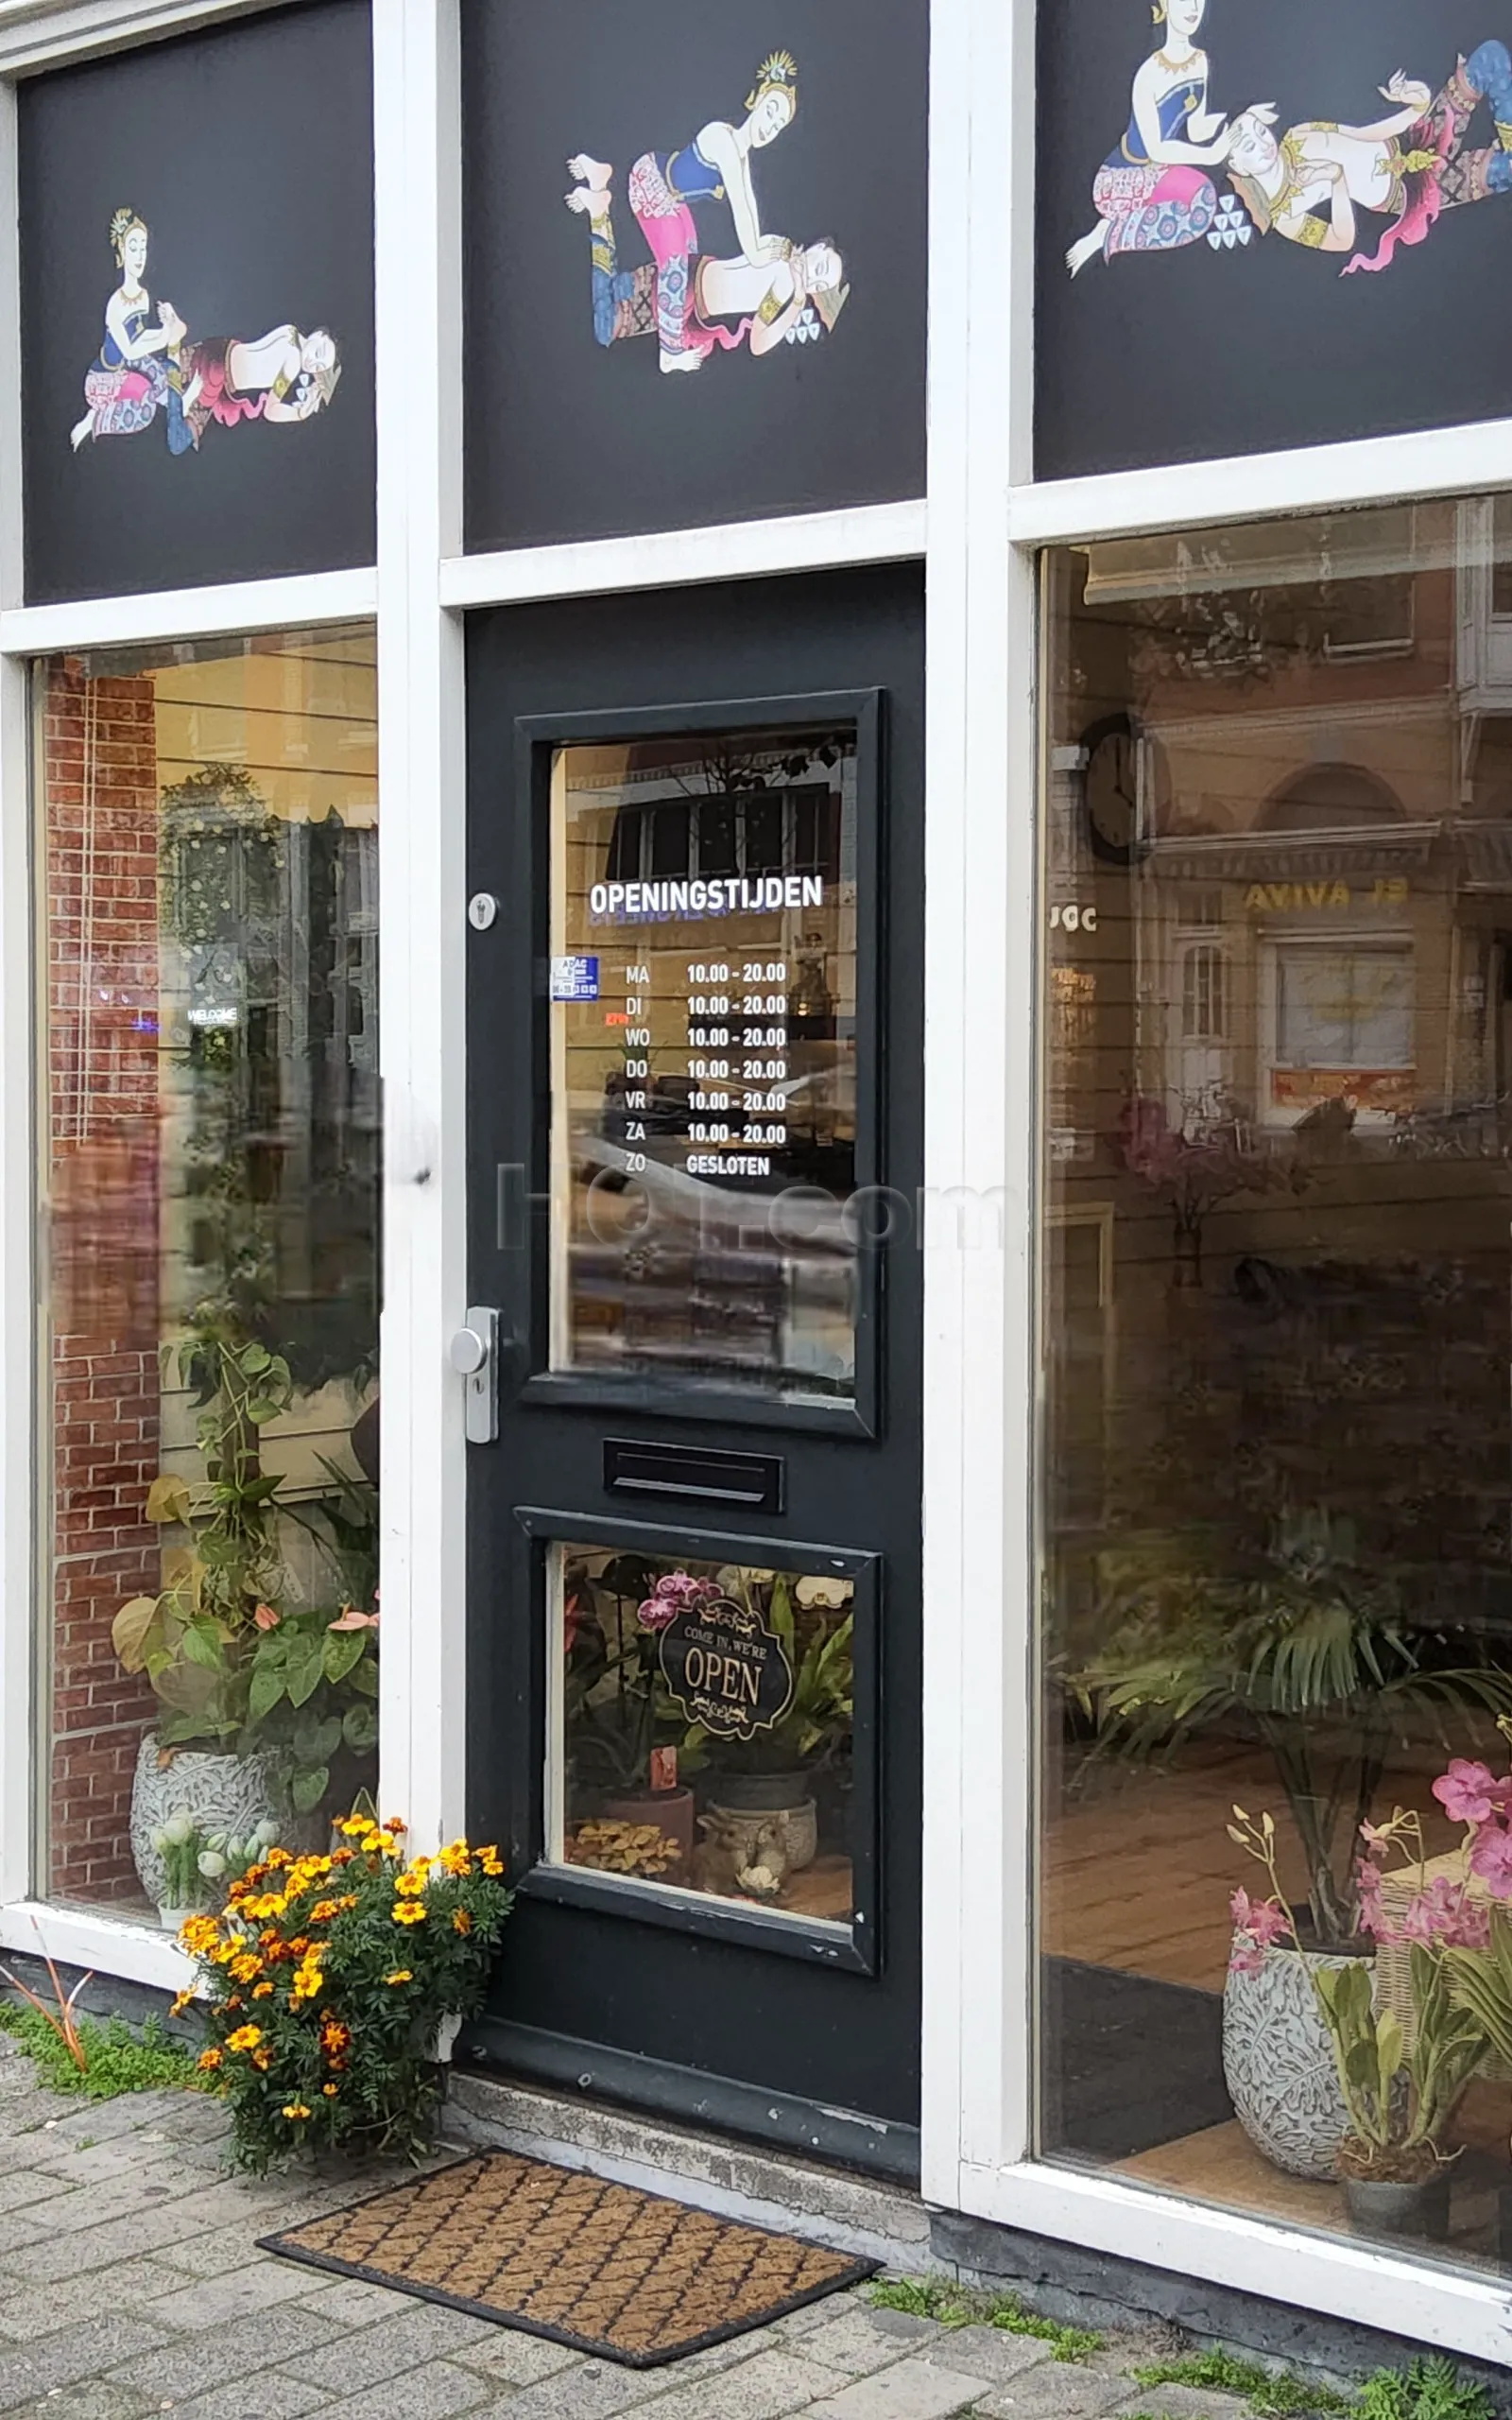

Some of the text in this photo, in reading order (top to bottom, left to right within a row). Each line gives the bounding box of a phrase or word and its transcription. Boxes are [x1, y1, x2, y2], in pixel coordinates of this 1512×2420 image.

[590, 875, 823, 914] OPENINGSTIJDEN
[626, 965, 649, 984] MA
[687, 963, 729, 983] 10.00
[743, 962, 786, 982] 20.00
[626, 997, 642, 1015] DI
[687, 996, 729, 1015] 10.00
[743, 995, 786, 1014] 20.00
[626, 1028, 650, 1046] WO
[687, 1029, 729, 1047] 10.00
[743, 1028, 786, 1046] 20.00
[626, 1060, 647, 1079] DO
[687, 1061, 729, 1080] 10.00
[743, 1060, 786, 1079] 20.00
[626, 1092, 646, 1110] VR
[687, 1093, 729, 1112] 10.00
[743, 1092, 786, 1111] 20.00
[626, 1122, 645, 1141] ZA
[687, 1125, 729, 1144] 10.00
[743, 1124, 786, 1143] 20.00
[626, 1152, 770, 1176] ZO GESLOTEN
[684, 1625, 714, 1645] COME
[685, 1647, 765, 1706] OPEN
